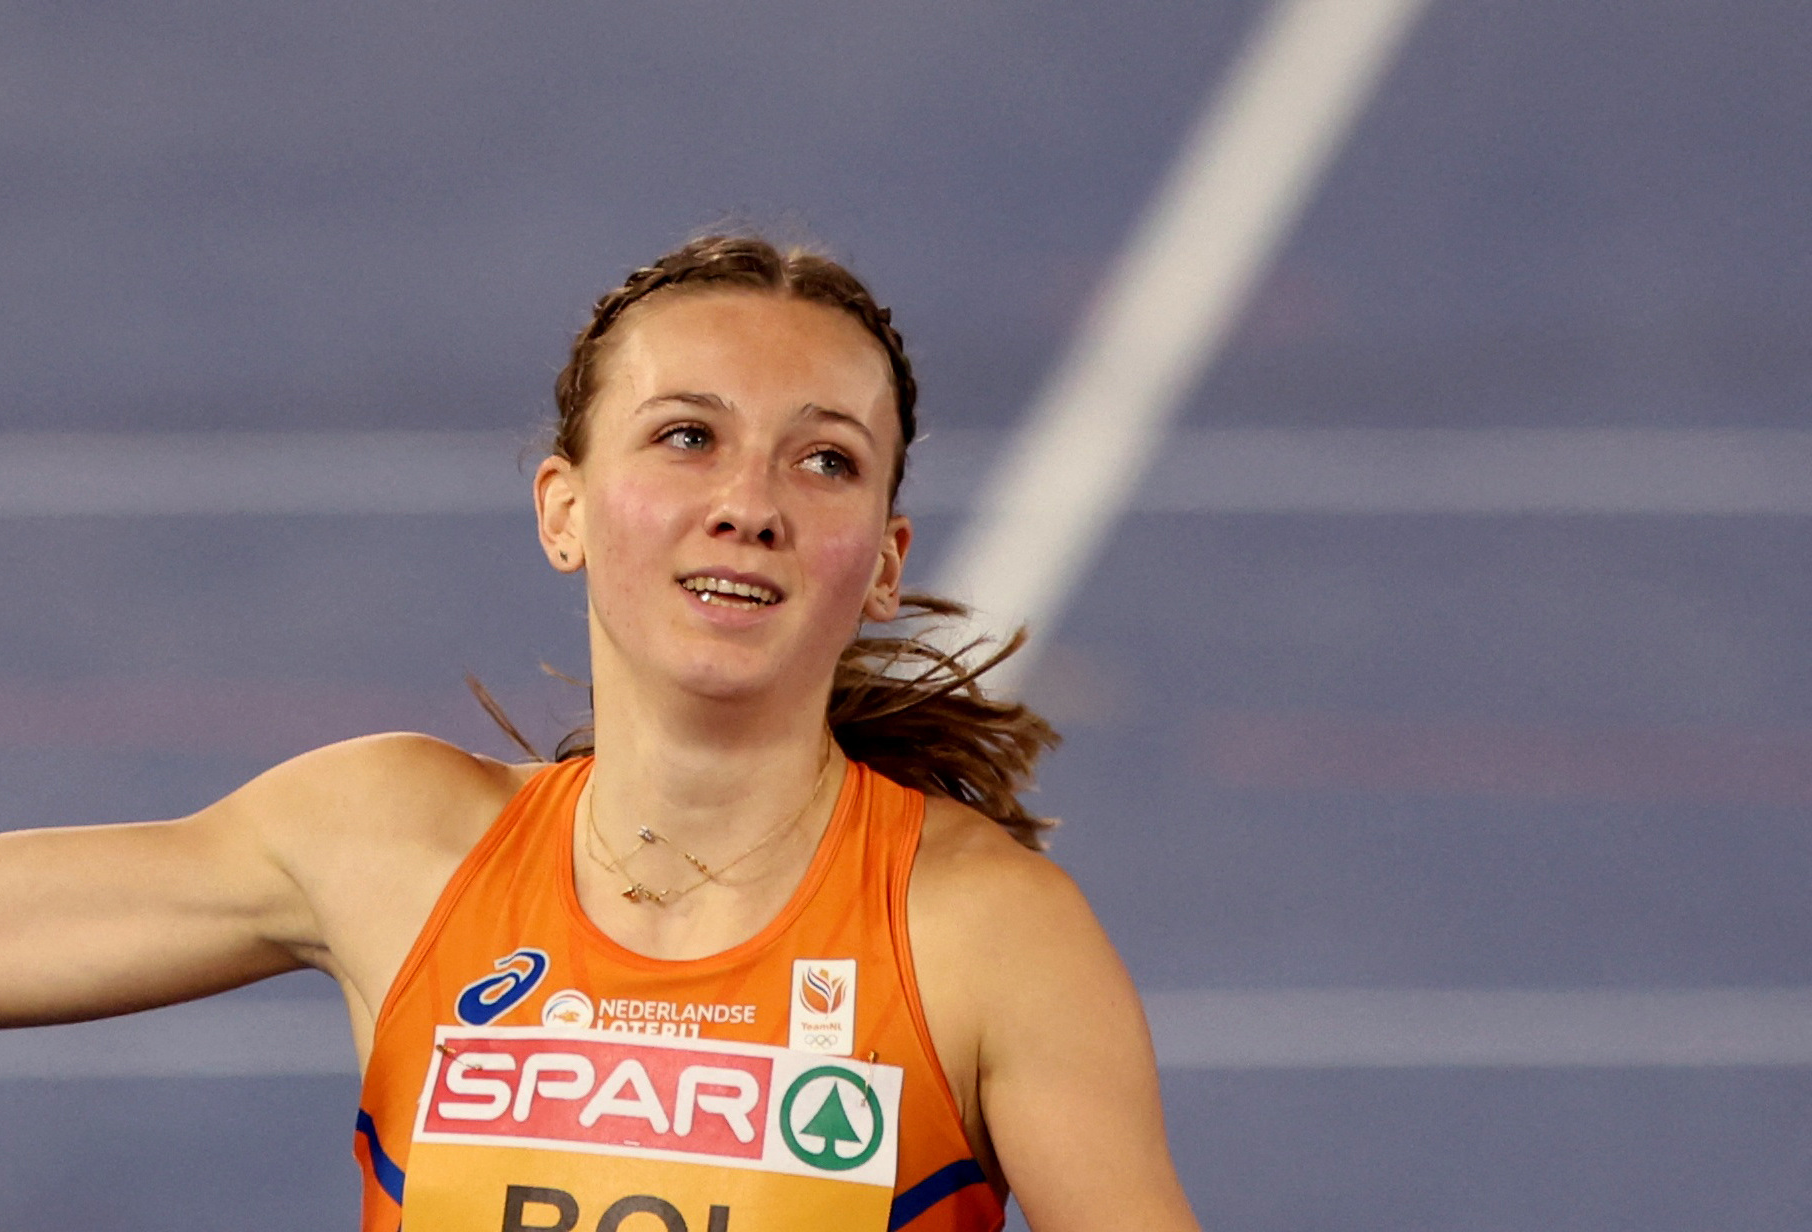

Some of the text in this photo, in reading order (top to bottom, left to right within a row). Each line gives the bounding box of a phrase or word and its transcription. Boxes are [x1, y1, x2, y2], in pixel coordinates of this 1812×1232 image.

[598, 998, 756, 1023] NEDERLANDSE
[801, 1022, 843, 1032] TeamNL
[438, 1052, 760, 1144] SPAR
